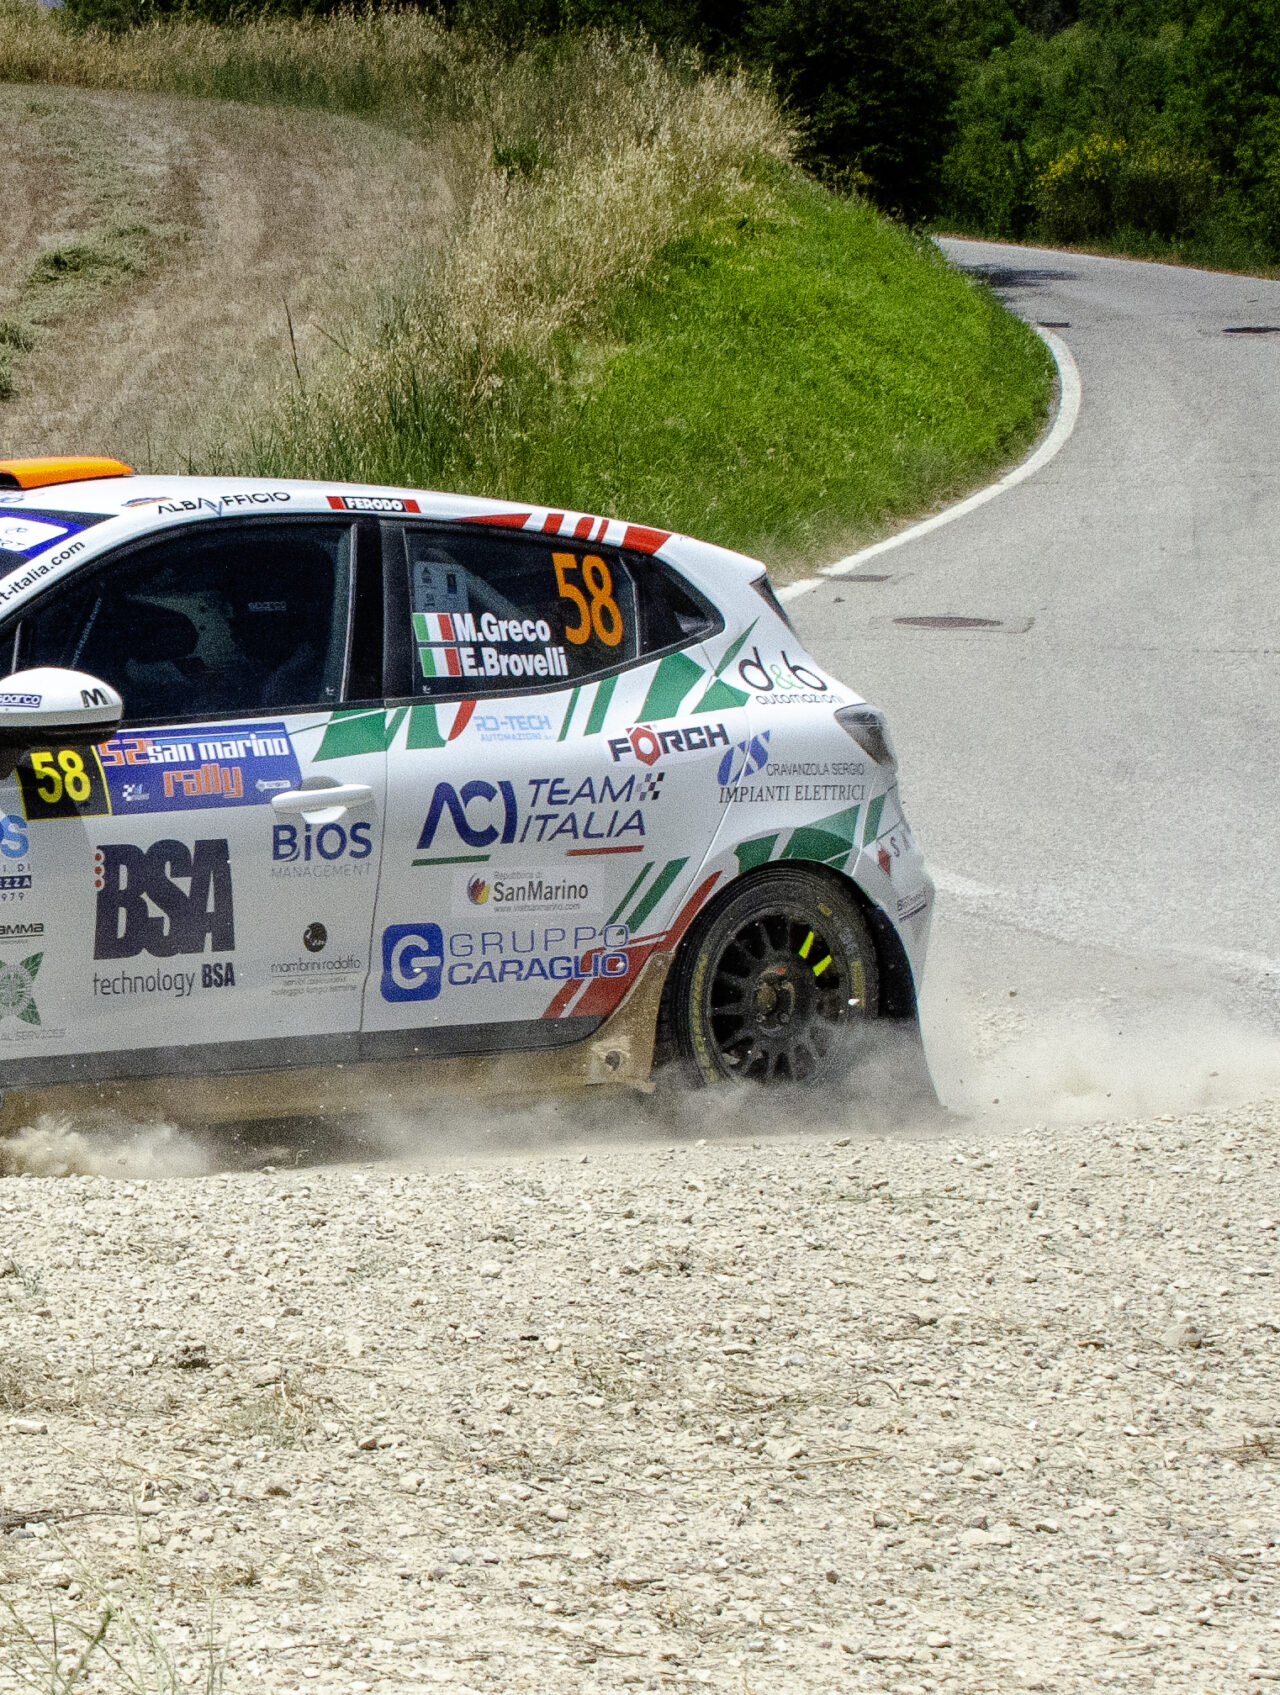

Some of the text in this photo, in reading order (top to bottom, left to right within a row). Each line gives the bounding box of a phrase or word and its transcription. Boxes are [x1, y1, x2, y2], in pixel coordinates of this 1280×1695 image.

[346, 497, 404, 511] FERODO
[552, 551, 623, 648] 58
[455, 613, 551, 642] M.Greco
[461, 647, 568, 677] E.Brovelli
[755, 693, 845, 705] automazioni
[148, 743, 195, 764] san
[200, 733, 290, 760] marino
[30, 750, 91, 803] 58
[163, 763, 243, 798] rally
[766, 763, 865, 776] CRAVANZOLA SERGIO
[527, 774, 637, 809] TEAM
[719, 784, 865, 803] IMPIANTI ELETTRICI
[416, 779, 517, 850] ACI
[519, 808, 646, 843] ITALIA
[17, 863, 31, 872] DI
[272, 862, 372, 878] MANAGEMENT
[94, 838, 235, 960] BSA
[493, 880, 588, 902] SanMarino
[449, 924, 629, 957] GRUPPO
[322, 953, 360, 969] rodolfo
[448, 951, 629, 986] CARAGLIO
[94, 962, 235, 998] technology BSA
